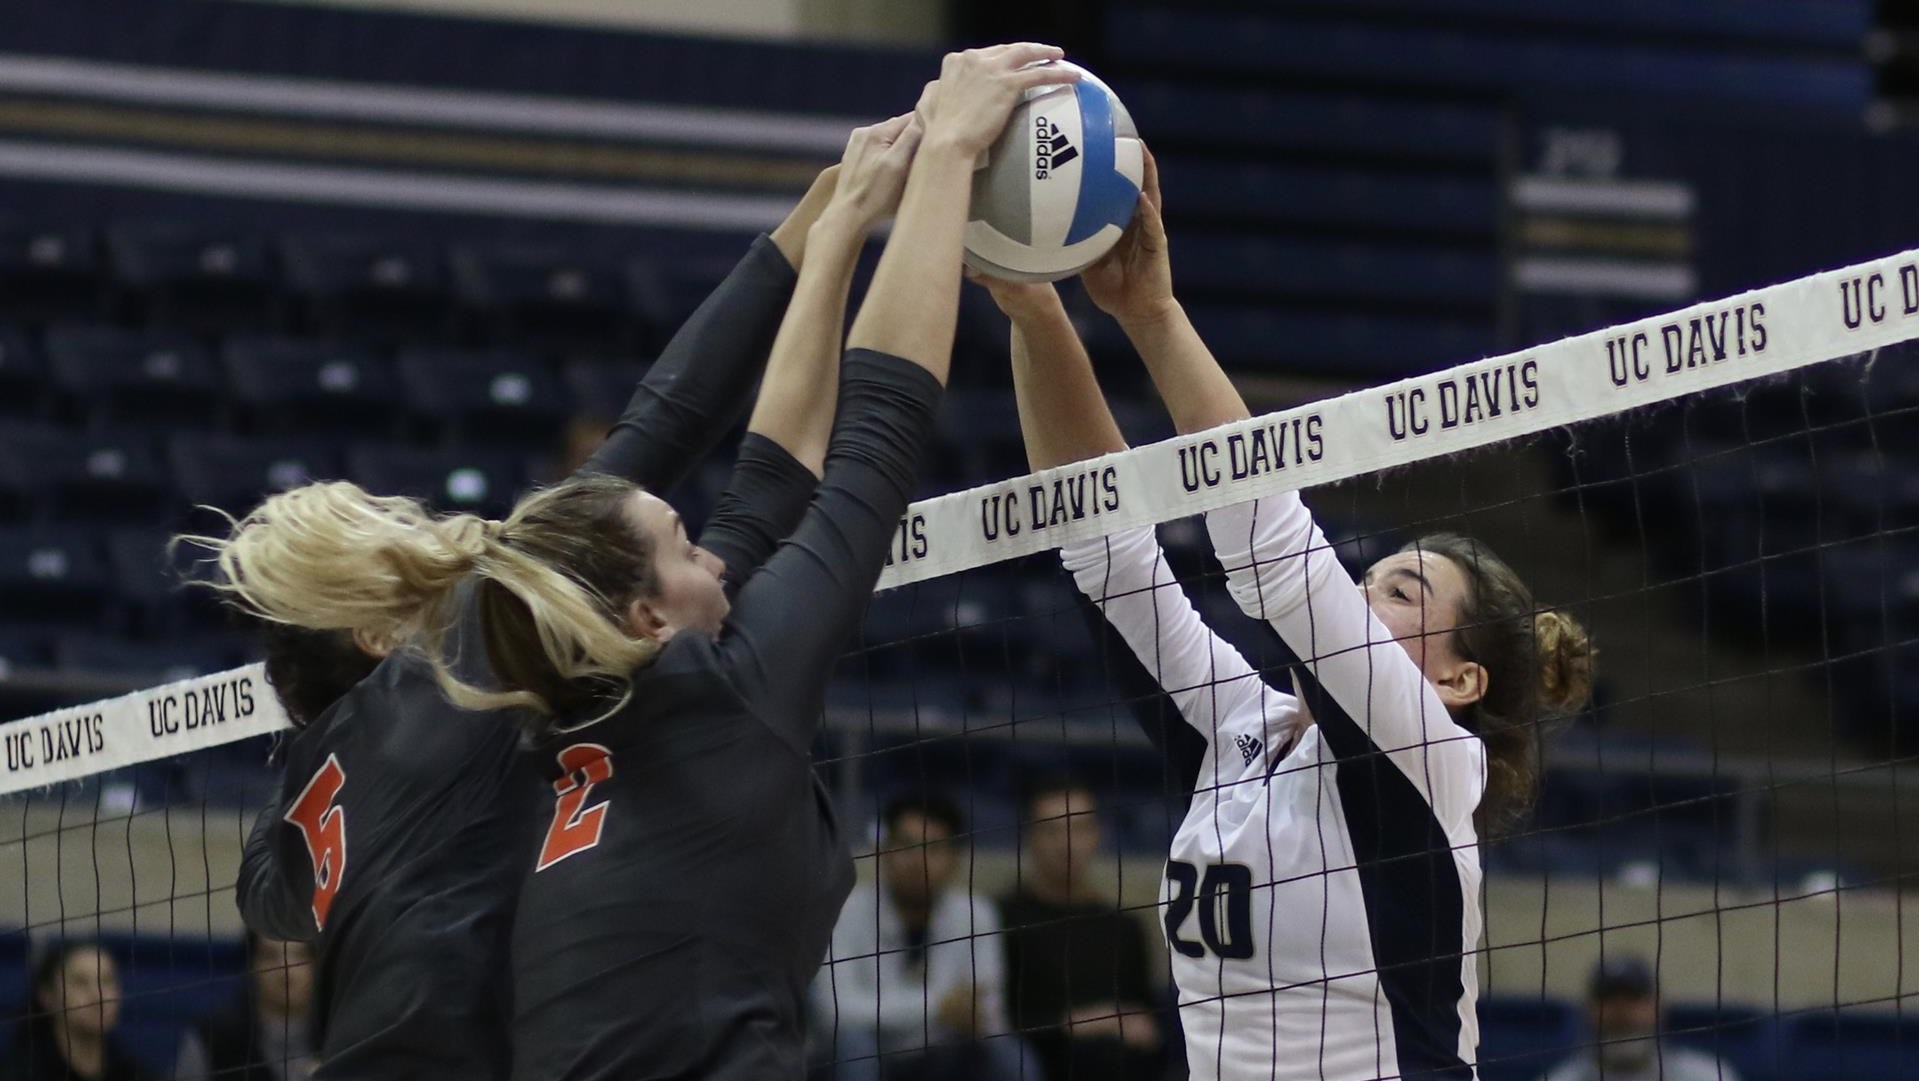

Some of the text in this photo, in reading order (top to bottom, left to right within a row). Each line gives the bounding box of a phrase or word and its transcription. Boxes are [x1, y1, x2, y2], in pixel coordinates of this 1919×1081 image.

[1035, 115, 1052, 180] adidas
[1840, 273, 1885, 329] UC
[1607, 303, 1767, 387] UC DAVIS
[1385, 361, 1539, 441] UC DAVIS
[1179, 415, 1324, 493] UC DAVIS
[886, 515, 928, 567] IS
[982, 466, 1120, 542] UC DAVIS
[6, 714, 104, 771] UC DAVIS
[148, 678, 255, 738] UC DAVIS
[536, 743, 613, 873] 2
[1165, 859, 1254, 960] 20
